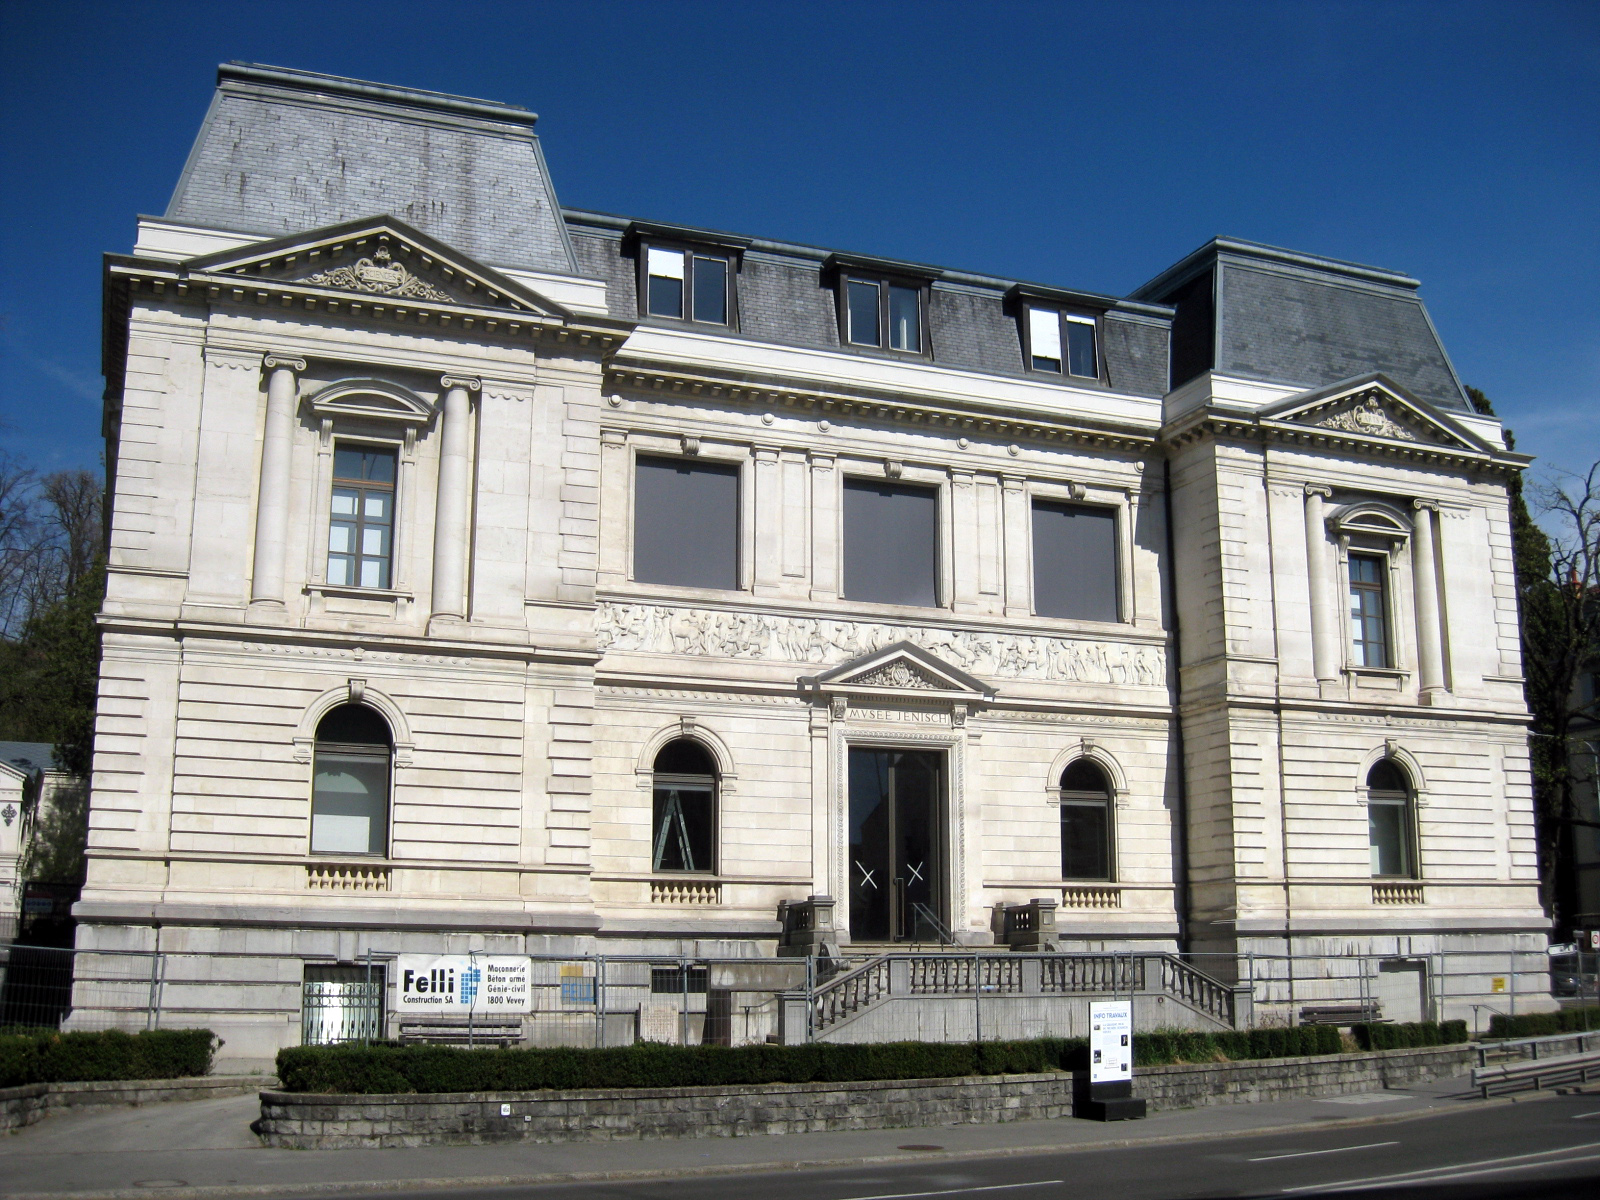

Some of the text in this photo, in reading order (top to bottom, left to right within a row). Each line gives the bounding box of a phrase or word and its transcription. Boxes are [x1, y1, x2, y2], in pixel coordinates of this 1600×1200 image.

[365, 269, 397, 280] SCIENCES
[849, 709, 947, 723] MVSEE JENISCH
[487, 964, 526, 973] Maçonnerie
[403, 968, 455, 993] Felli
[487, 974, 526, 983] Béton armé
[487, 984, 526, 993] Génie-civil
[402, 995, 454, 1004] Construction SA
[487, 996, 526, 1007] 1800 Vevey
